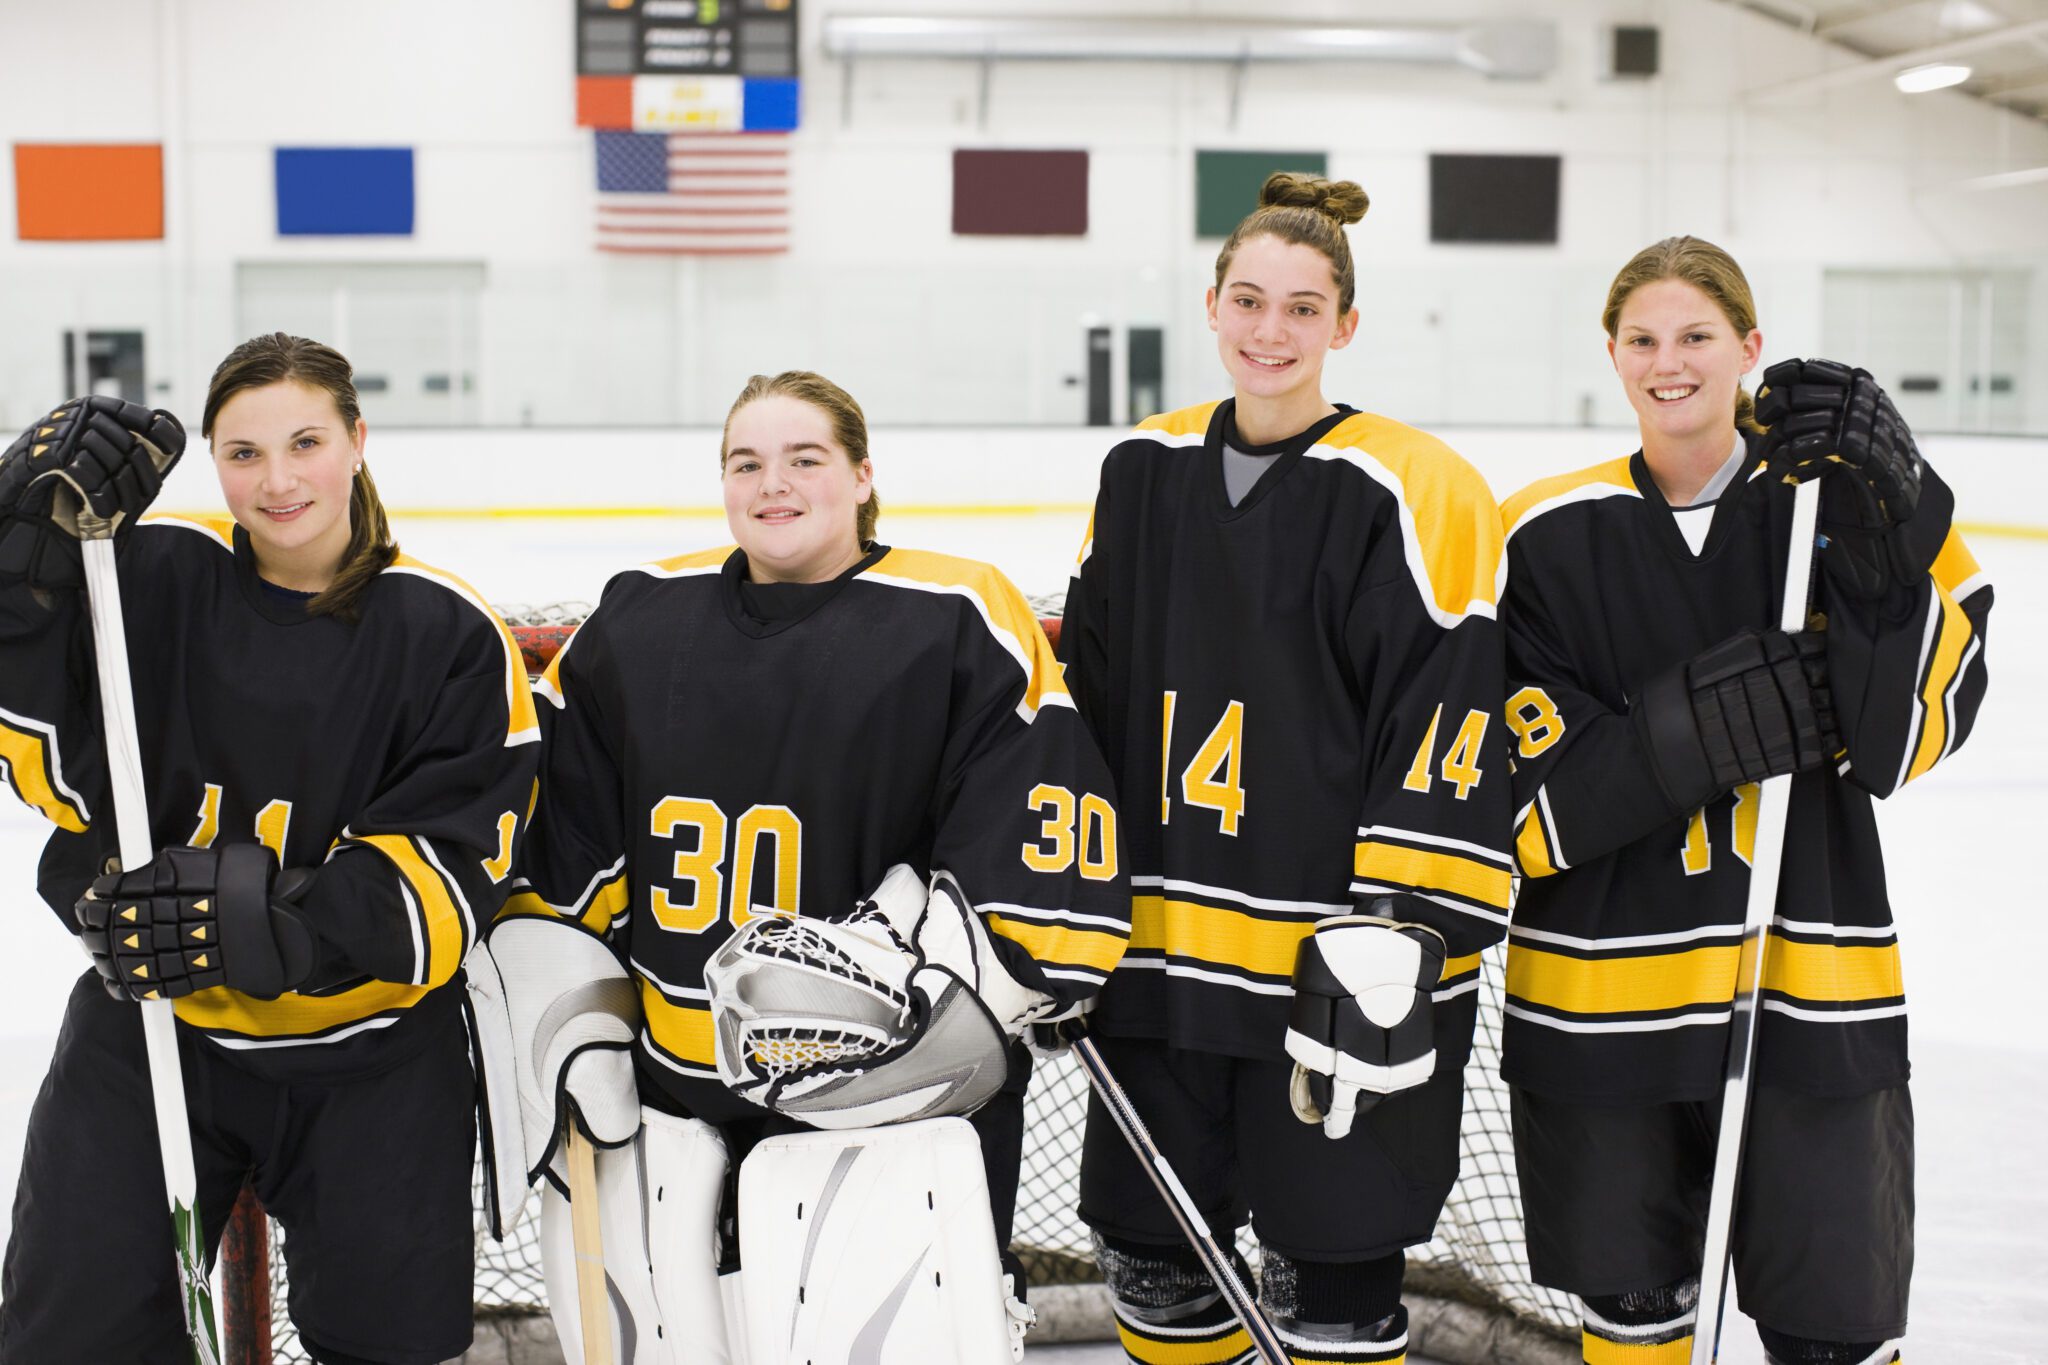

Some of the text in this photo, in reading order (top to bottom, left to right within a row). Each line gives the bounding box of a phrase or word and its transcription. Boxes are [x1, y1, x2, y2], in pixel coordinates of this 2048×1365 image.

[1403, 703, 1490, 800] 14
[651, 796, 801, 934] 30
[1022, 783, 1118, 881] 30
